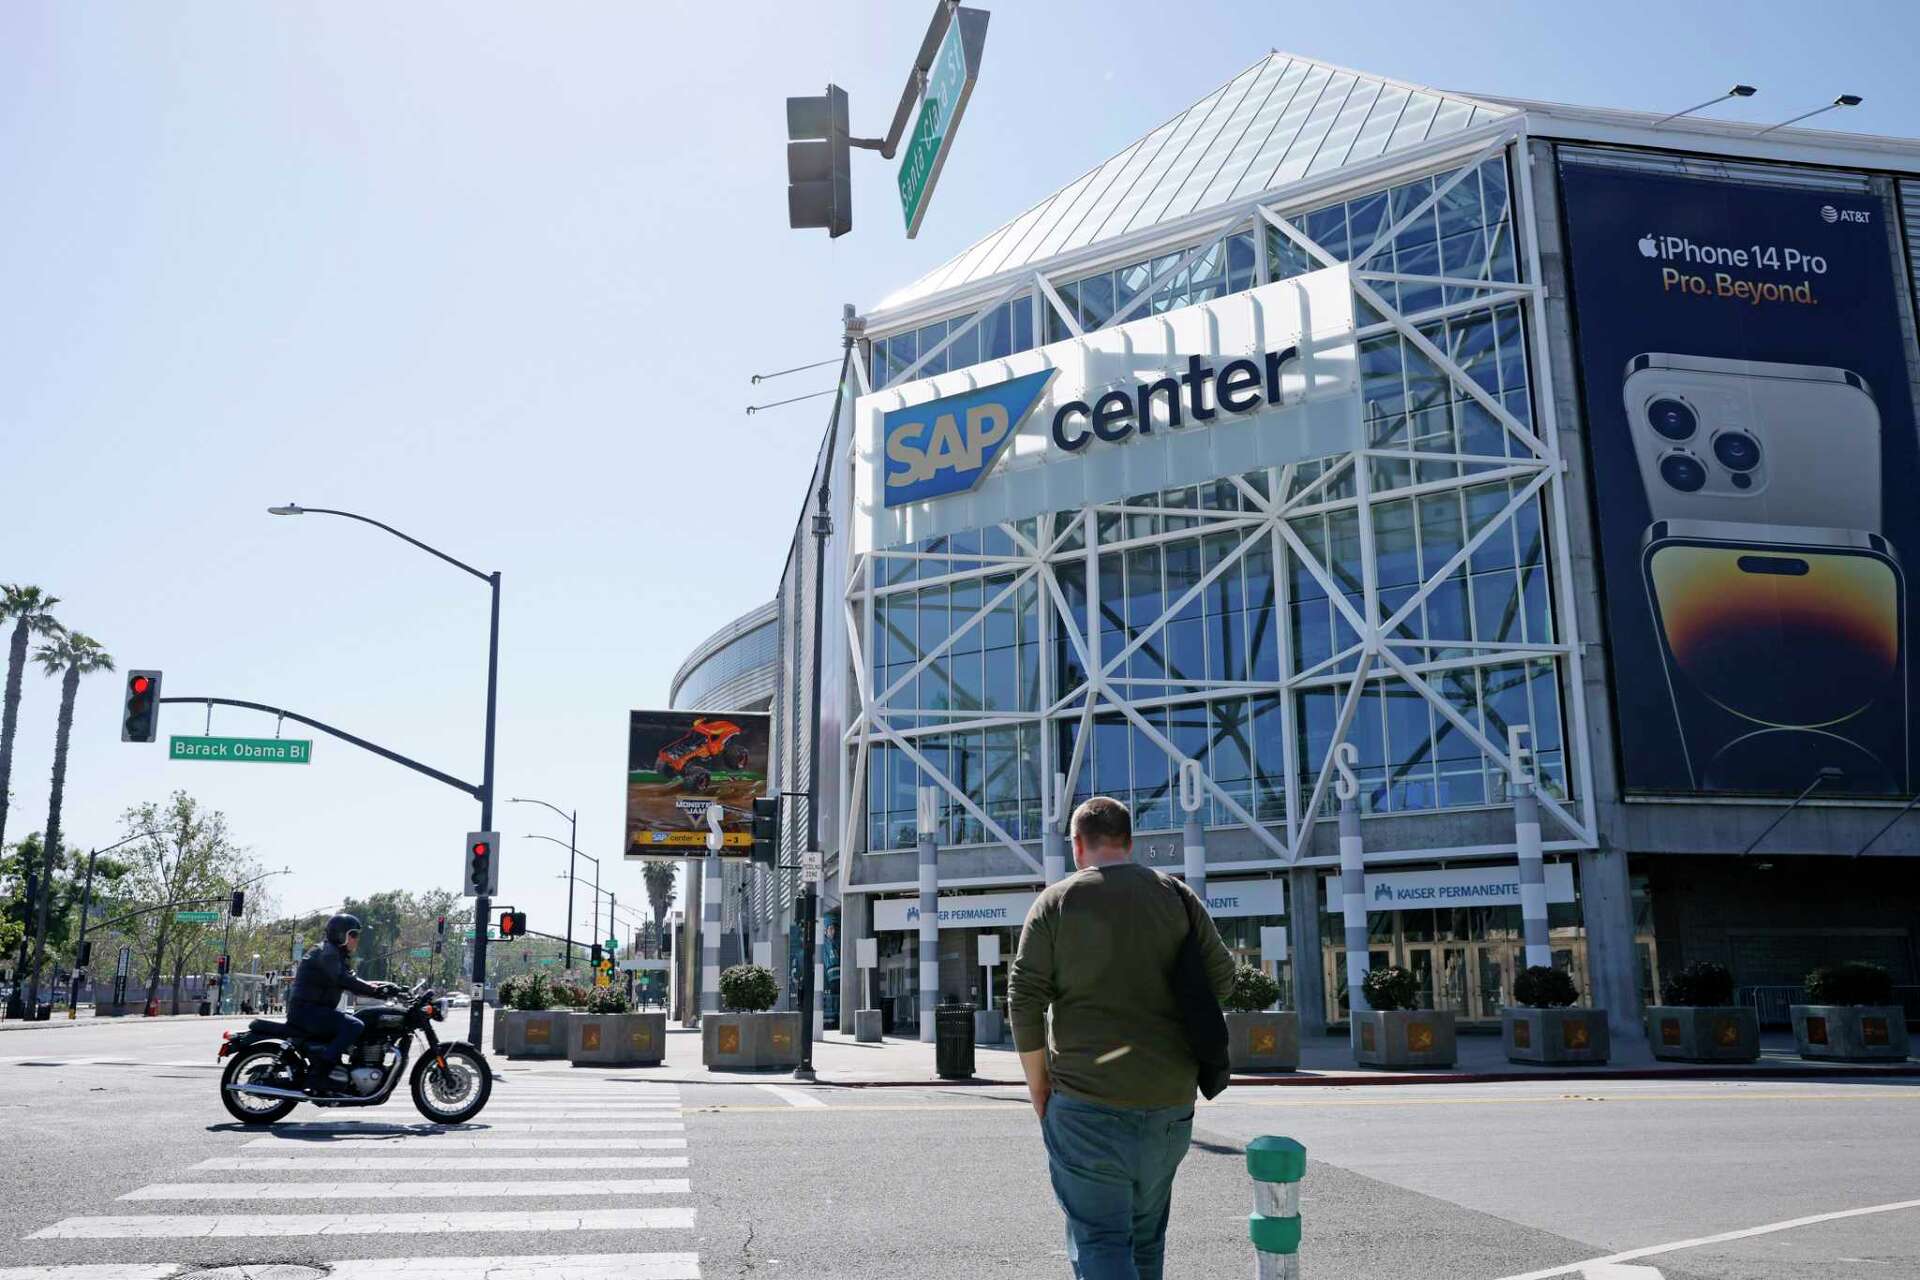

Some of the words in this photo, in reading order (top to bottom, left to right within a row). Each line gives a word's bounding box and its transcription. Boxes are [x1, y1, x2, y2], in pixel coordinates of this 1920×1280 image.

[902, 146, 925, 211] Santa
[922, 81, 949, 148] Clara
[1840, 210, 1871, 224] AT&T
[1659, 235, 1749, 267] iPhone
[1751, 246, 1781, 270] 14
[1784, 248, 1828, 274] Pro
[1662, 267, 1712, 295] Pro.
[1715, 273, 1818, 305] Beyond.
[885, 402, 1010, 488] SAP
[1051, 345, 1297, 453] center
[175, 741, 228, 756] Barack
[233, 743, 285, 758] Obama
[1397, 886, 1436, 900] KAISER
[1438, 883, 1520, 899] PERMANENTE
[1206, 897, 1240, 909] NENTE
[951, 907, 1007, 920] PERMANENTE
